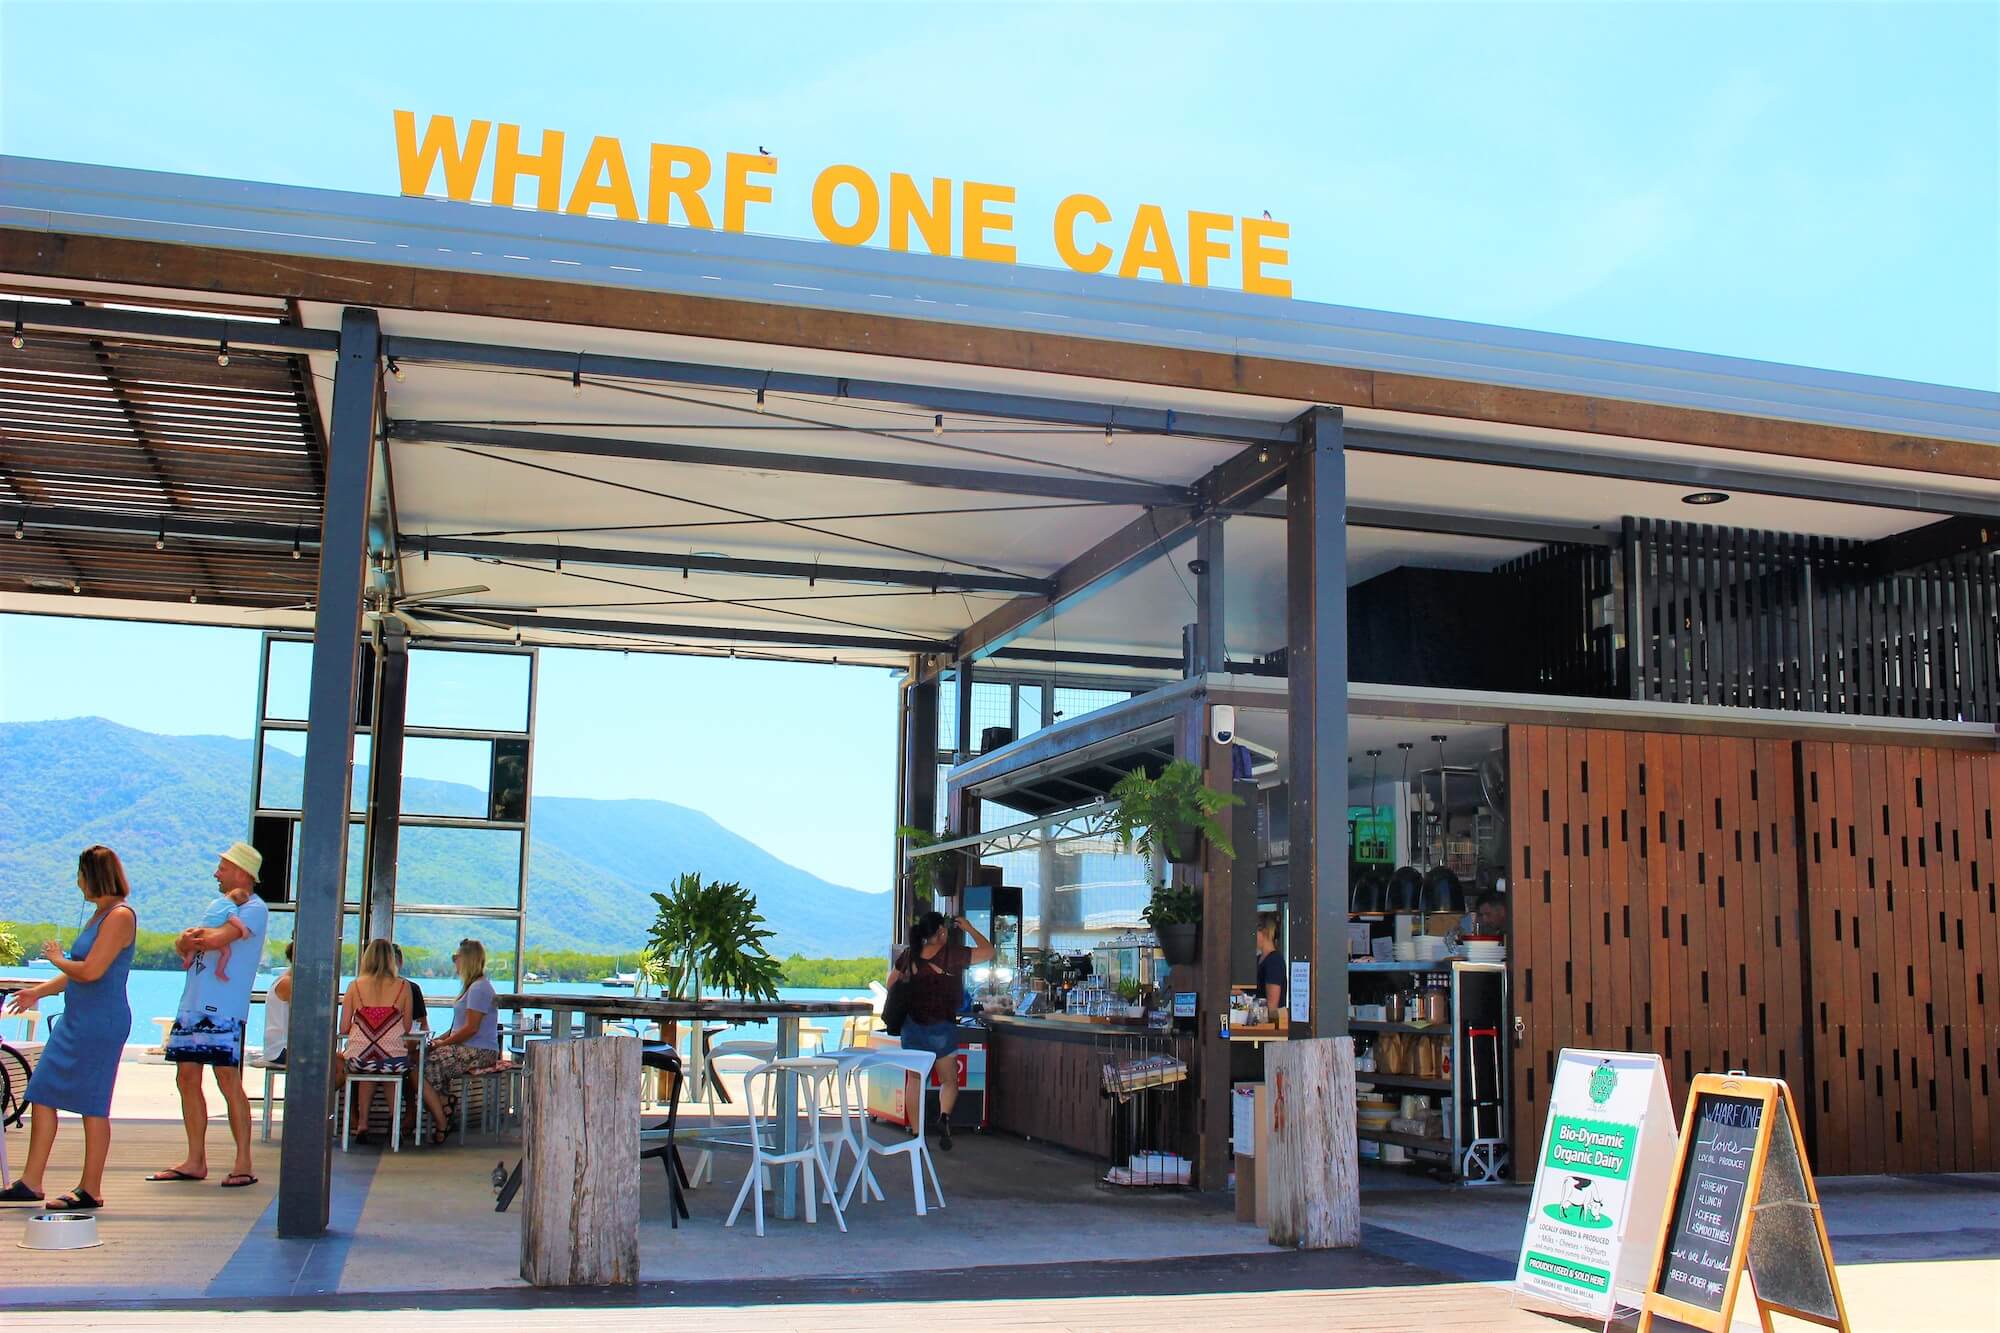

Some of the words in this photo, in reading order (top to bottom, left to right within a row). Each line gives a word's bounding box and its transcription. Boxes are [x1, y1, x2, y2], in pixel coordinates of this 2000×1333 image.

[393, 110, 778, 233] WHARF
[811, 164, 1017, 264] ONE
[1053, 194, 1293, 298] CAFE
[1704, 1101, 1741, 1125] WHARF
[1740, 1104, 1763, 1129] ONE
[1560, 1125, 1625, 1149] Bio-Dynamic
[1553, 1144, 1593, 1165] Organic
[1594, 1150, 1624, 1173] Dairy
[1698, 1153, 1716, 1165] LOCAL
[1539, 1223, 1558, 1233] LOCALLY
[1583, 1233, 1610, 1245] PRODUCED
[1529, 1259, 1553, 1273] PROUDLY
[1553, 1264, 1569, 1277] USED
[1569, 1269, 1575, 1279] &
[1575, 1270, 1590, 1282] SOLD
[1590, 1274, 1606, 1286] HERE
